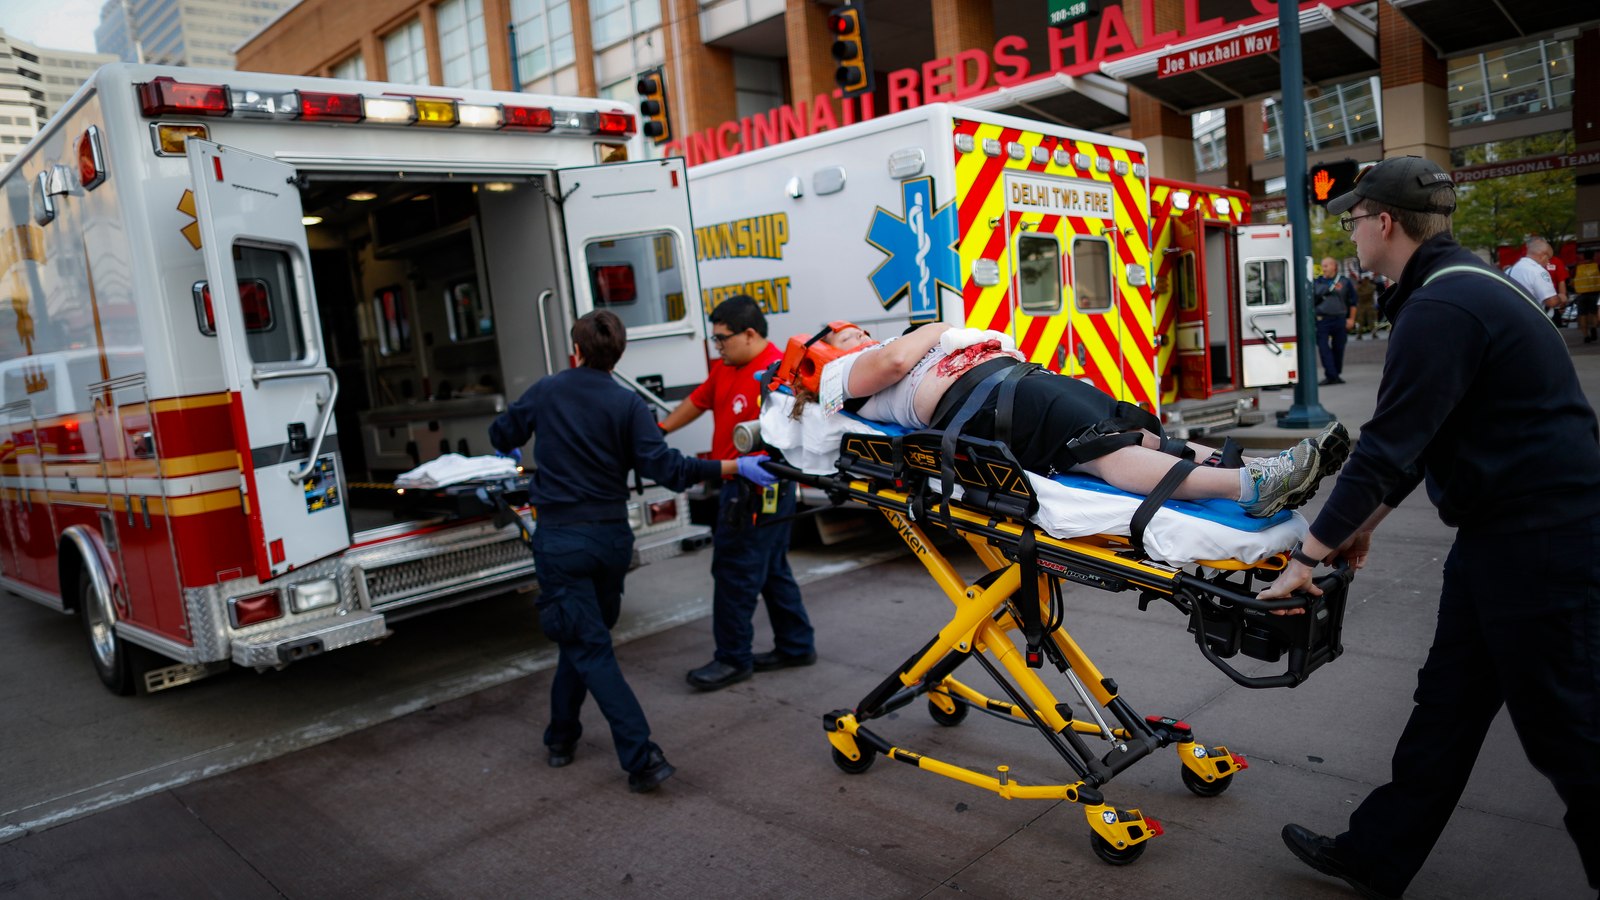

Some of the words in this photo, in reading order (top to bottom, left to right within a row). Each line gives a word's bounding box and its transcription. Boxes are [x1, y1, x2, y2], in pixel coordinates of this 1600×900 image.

[887, 35, 1031, 115] REDS
[1047, 0, 1225, 75] HALL
[1162, 57, 1185, 75] Joe
[1189, 41, 1241, 68] Nuxhall
[1244, 34, 1273, 54] Way
[1454, 160, 1555, 183] PROFESSIONAL
[1012, 182, 1050, 207] DELHI
[1052, 187, 1082, 210] TWP.
[1084, 191, 1109, 213] FIRE
[910, 451, 936, 466] XPS
[882, 508, 927, 555] tryker
